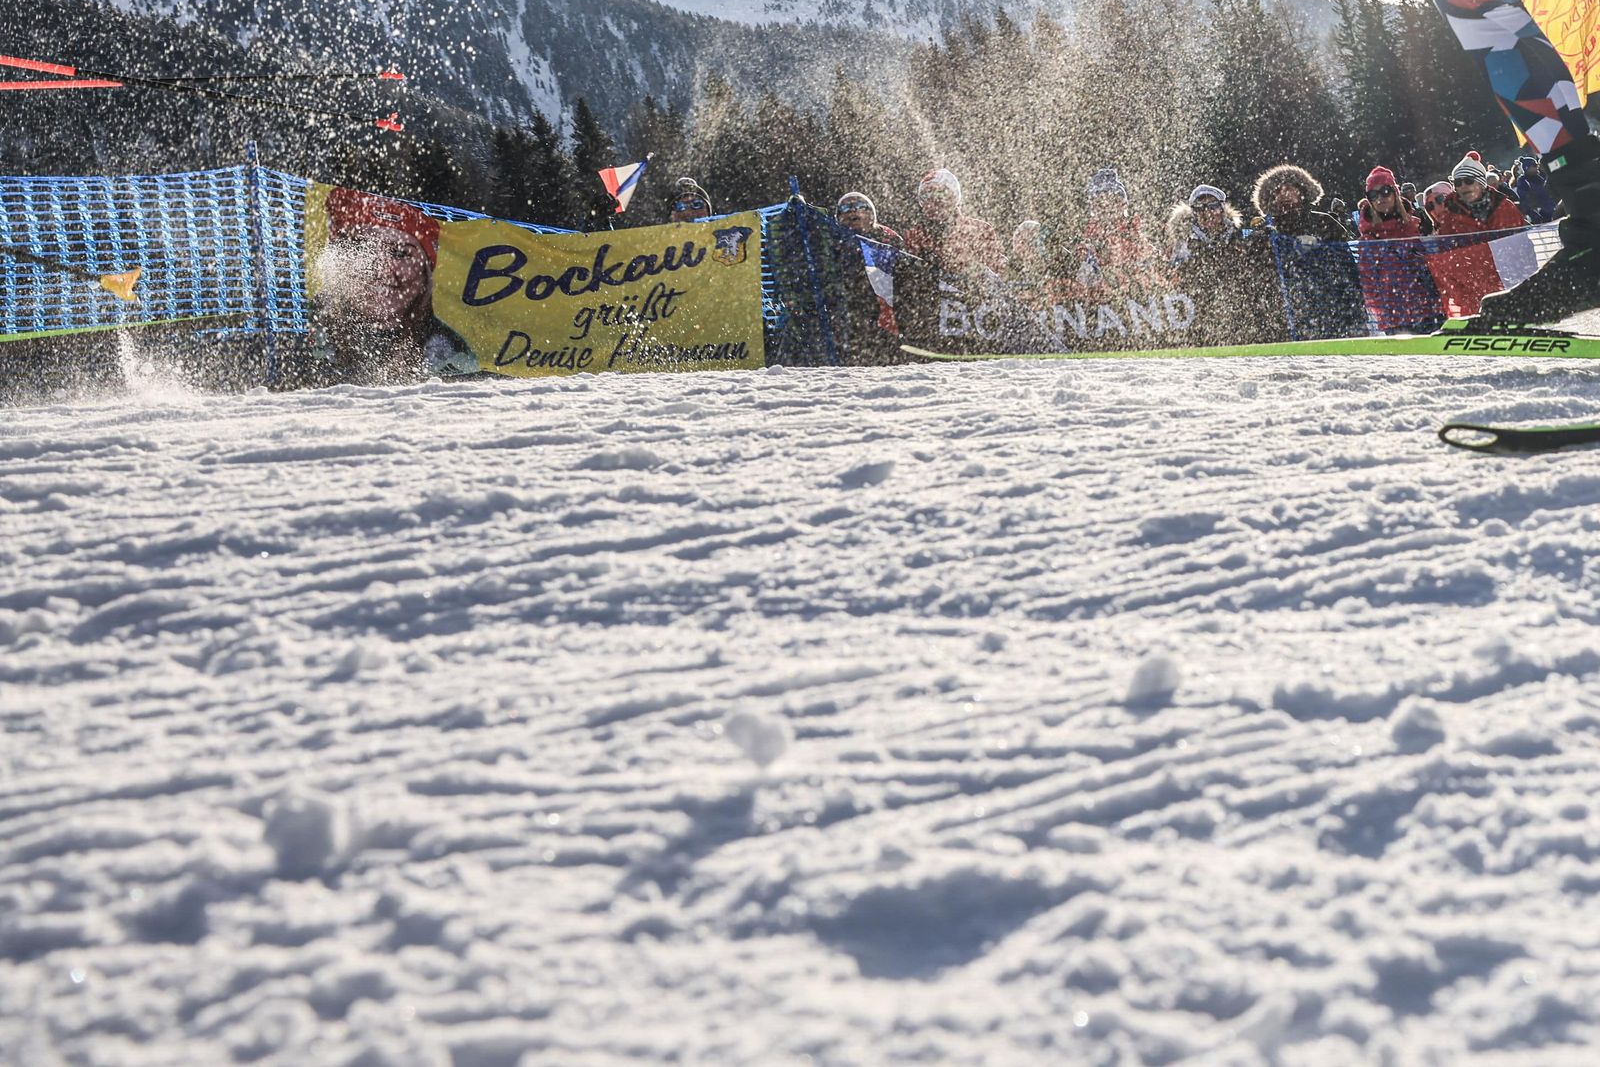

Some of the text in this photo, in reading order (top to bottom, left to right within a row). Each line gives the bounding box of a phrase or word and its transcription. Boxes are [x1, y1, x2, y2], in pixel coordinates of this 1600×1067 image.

[462, 242, 707, 307] Bockau
[569, 282, 688, 340] grüßt
[939, 292, 1198, 340] BONAND
[495, 330, 594, 369] Denise
[1442, 335, 1572, 354] FISCHER
